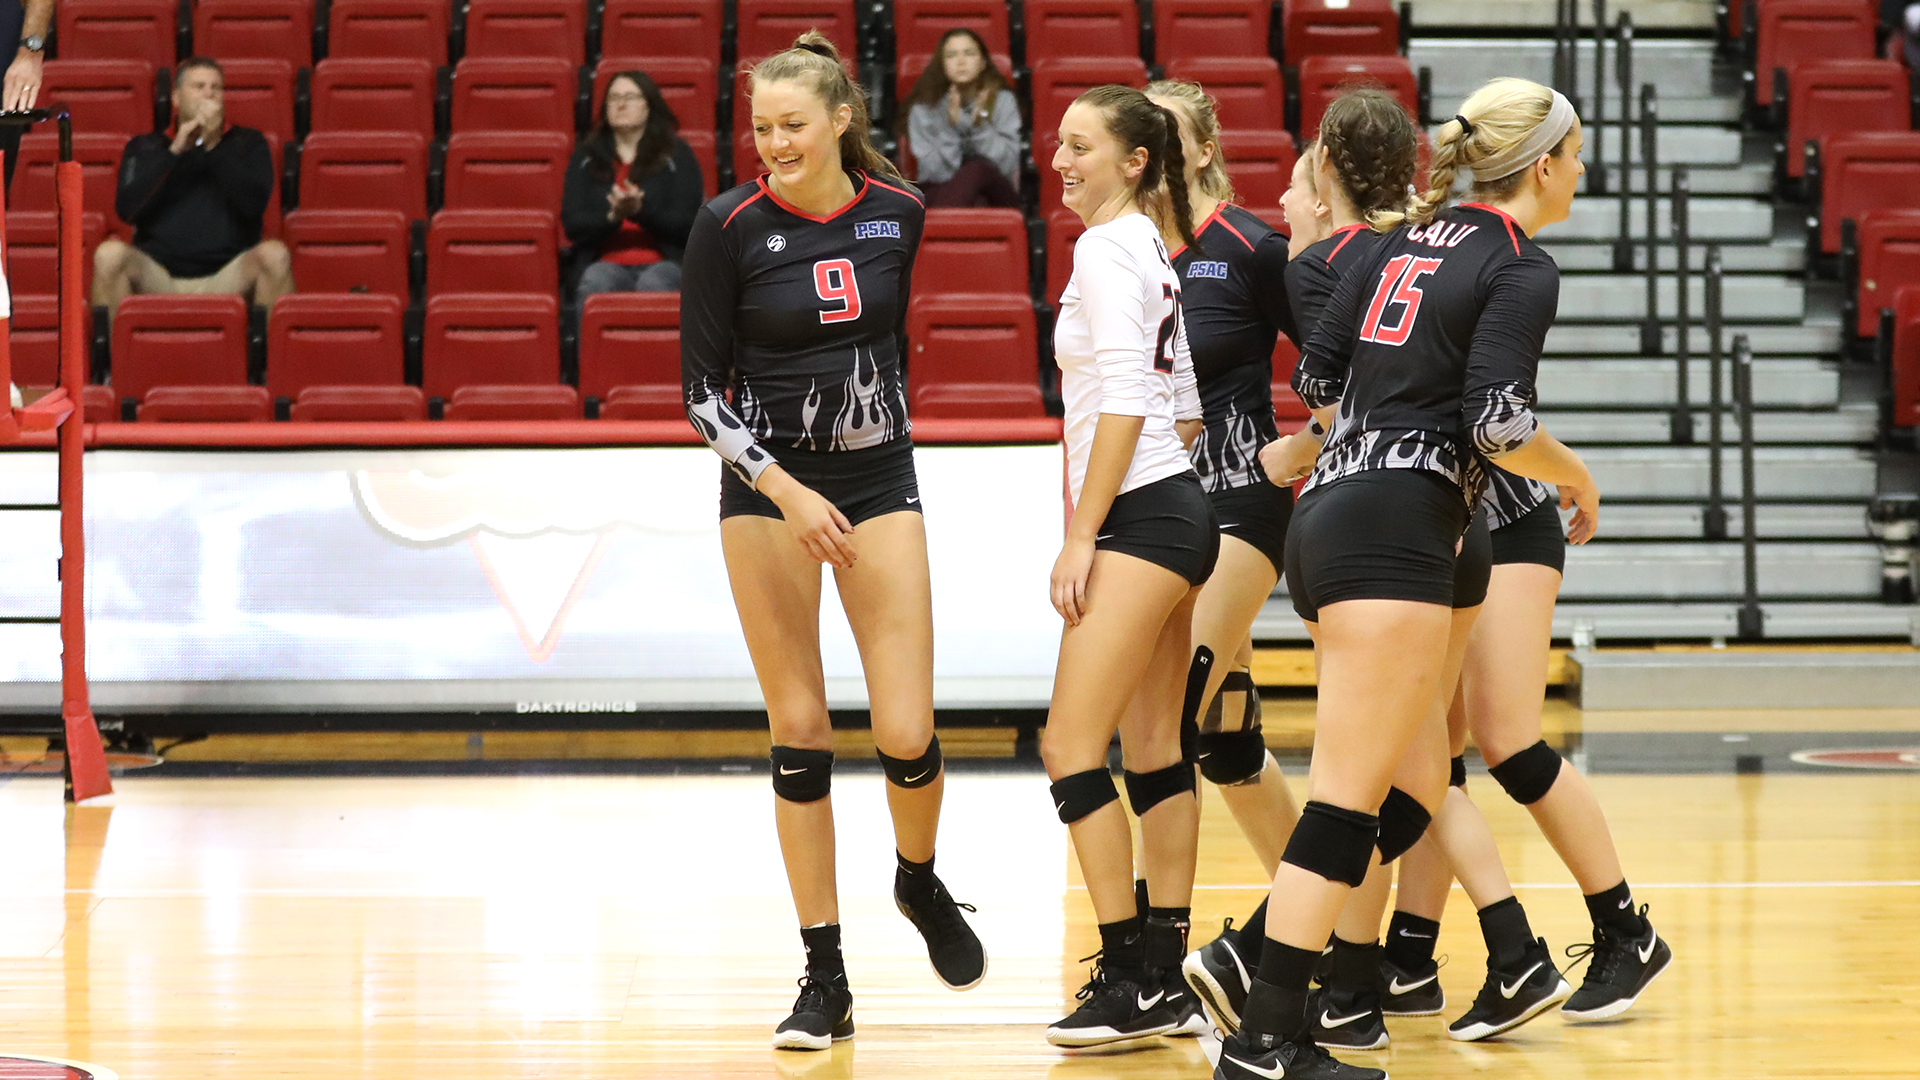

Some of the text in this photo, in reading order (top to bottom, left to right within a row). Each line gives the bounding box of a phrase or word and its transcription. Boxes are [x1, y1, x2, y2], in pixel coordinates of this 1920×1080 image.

[854, 221, 900, 239] PSAC
[1186, 261, 1229, 279] PSAC
[813, 258, 862, 324] 9
[1359, 254, 1443, 346] 15
[516, 701, 637, 713] DAKTRONICS
